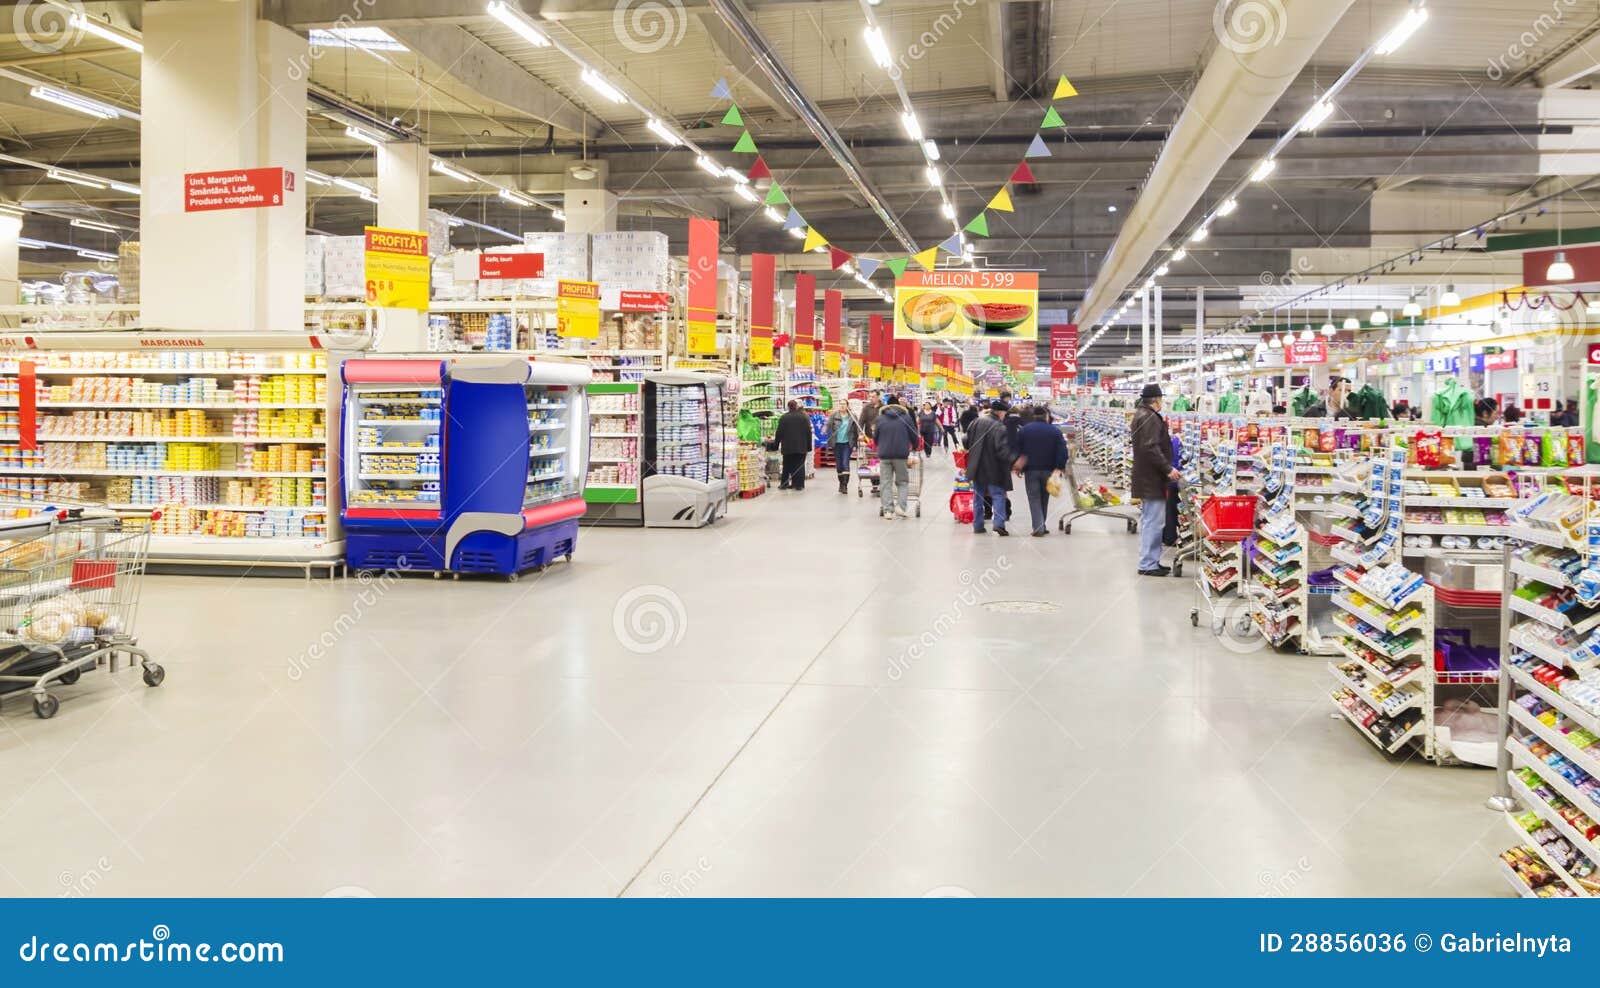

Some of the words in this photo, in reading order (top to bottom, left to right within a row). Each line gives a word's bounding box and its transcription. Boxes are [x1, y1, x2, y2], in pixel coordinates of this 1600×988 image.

[189, 177, 206, 185] Unt,
[207, 174, 247, 184] Margarină
[232, 184, 255, 194] Lapte
[189, 197, 223, 206] Produse
[224, 195, 264, 204] congelate
[273, 194, 279, 203] 8
[921, 274, 974, 286] MELLON
[980, 272, 1015, 288] 5,99
[1537, 382, 1549, 392] 13
